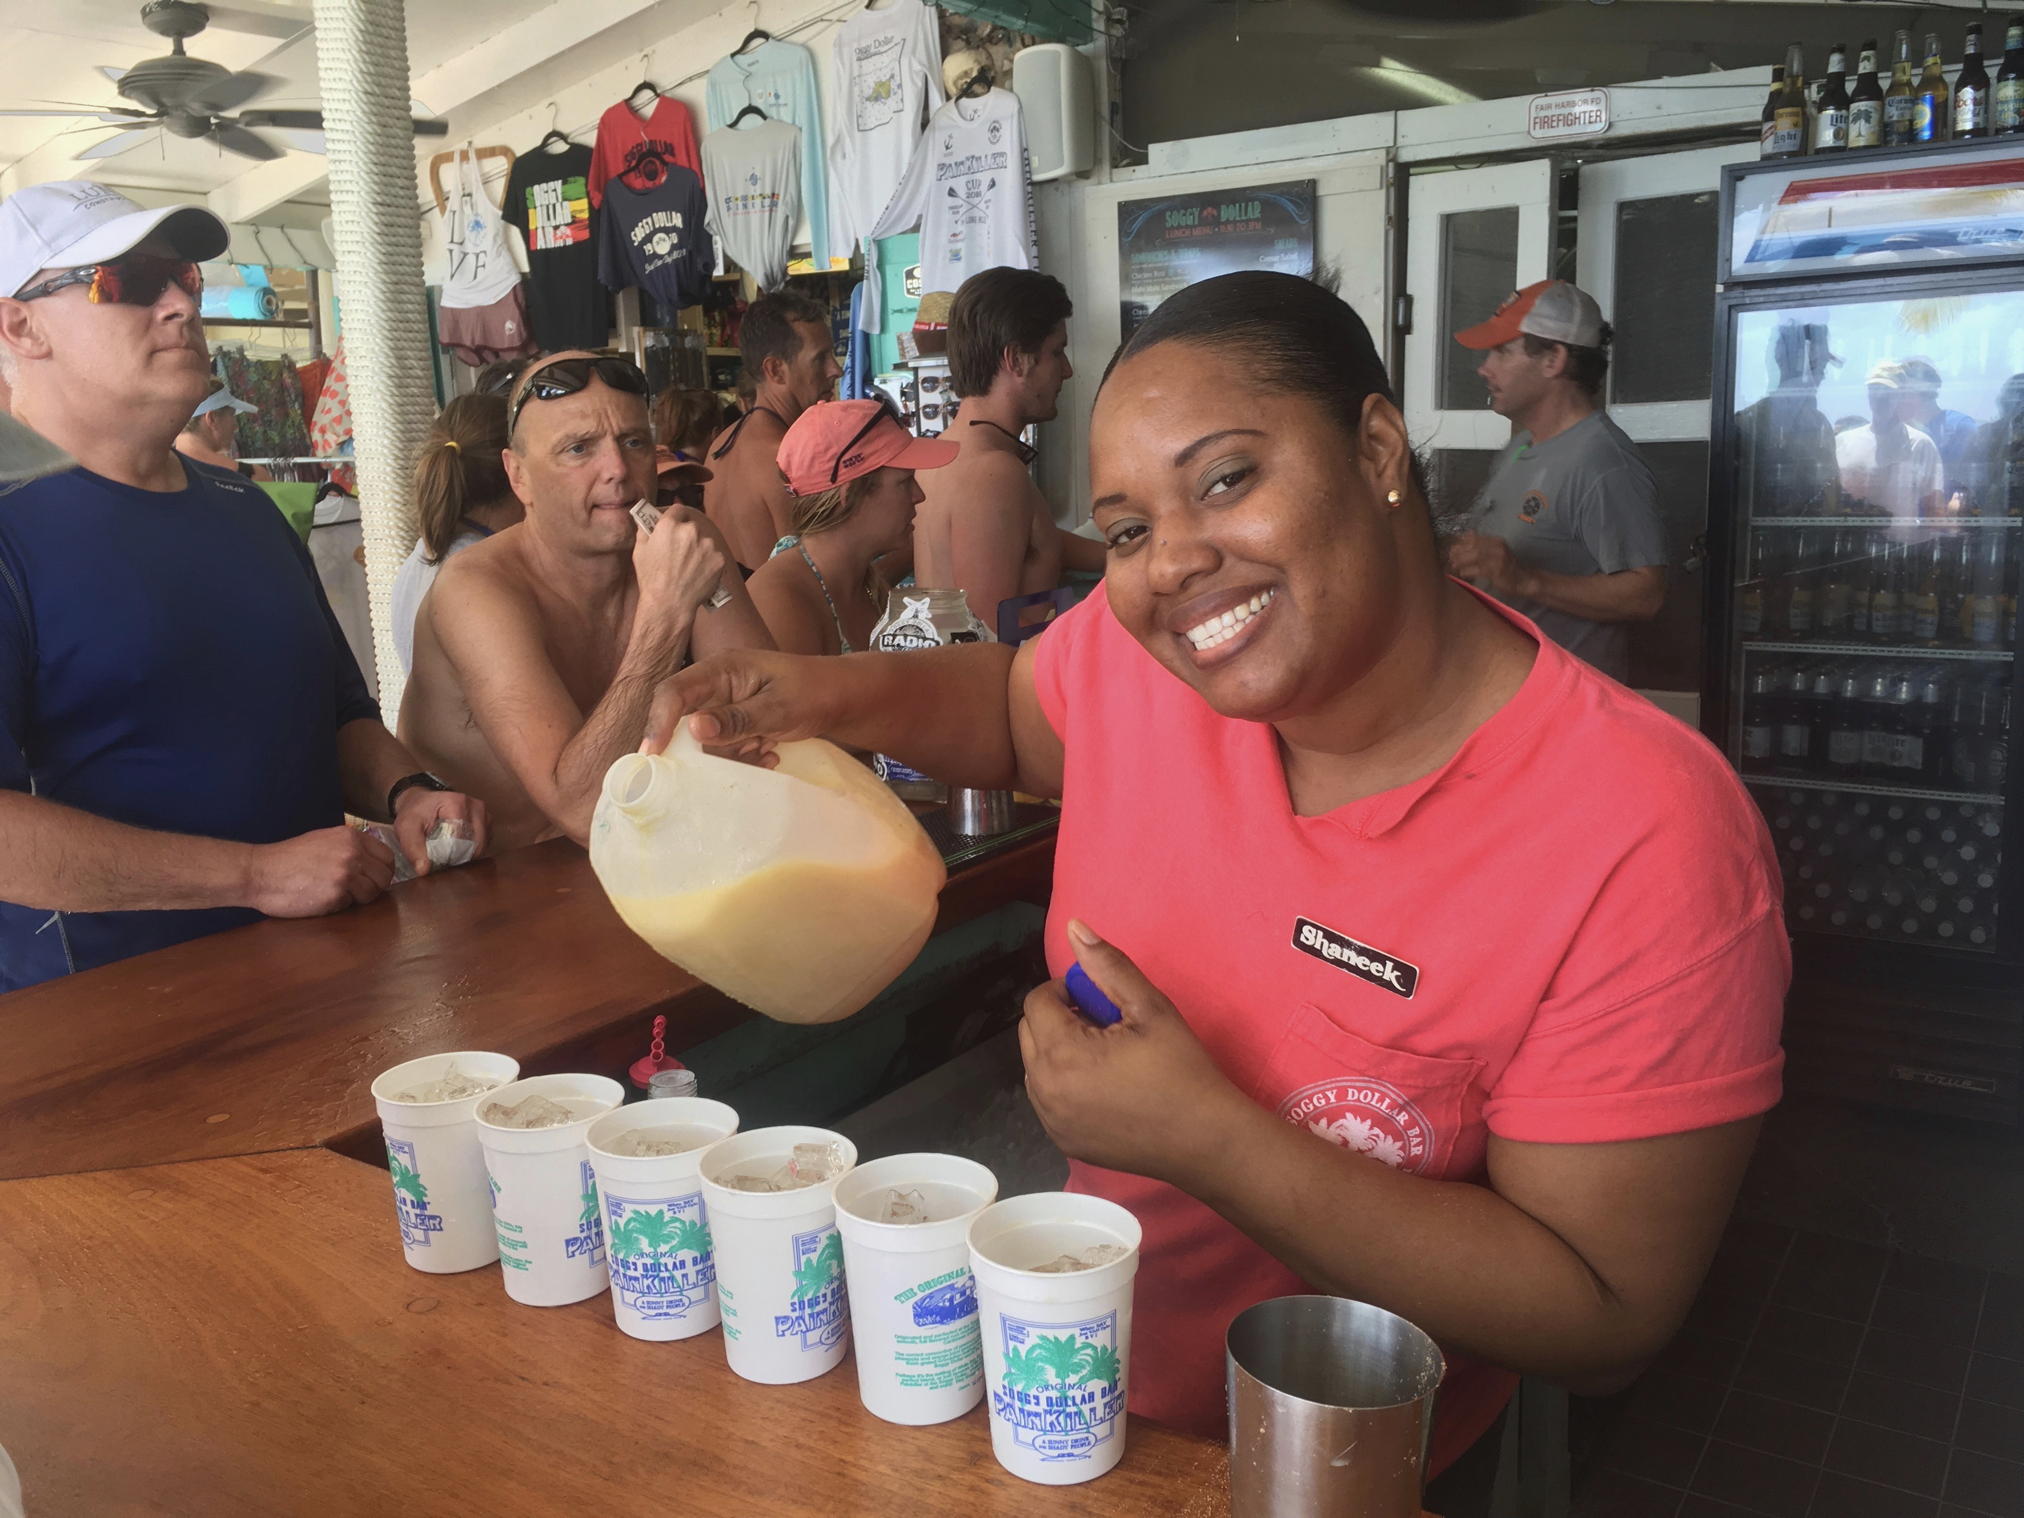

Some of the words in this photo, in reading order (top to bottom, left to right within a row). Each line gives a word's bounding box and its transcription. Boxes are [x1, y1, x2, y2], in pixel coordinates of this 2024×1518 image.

[1533, 109, 1602, 131] FIREFIGHTER
[1535, 103, 1553, 113] FAIR
[936, 151, 1008, 182] PAINKILLER
[630, 214, 655, 246] SOGGY
[652, 211, 683, 229] DOLLAR
[1165, 208, 1201, 229] SOGGY
[1219, 201, 1263, 223] DOLLAR
[884, 635, 937, 648] RADIO
[1300, 925, 1407, 992] Shaneek
[1346, 1088, 1409, 1126] DOLLAR
[1406, 1126, 1424, 1157] BAR
[633, 1250, 678, 1261] ORIGINAL
[642, 1259, 687, 1273] DOLLAR
[894, 1287, 917, 1304] THE
[917, 1267, 966, 1293] ORIGINAL
[1002, 1384, 1041, 1407] SOGGY
[1046, 1391, 1096, 1408] DOLLAR
[1101, 1381, 1118, 1399] BAR
[1036, 1382, 1088, 1394] ORIGINAL
[993, 1389, 1125, 1433] PAINKILLER
